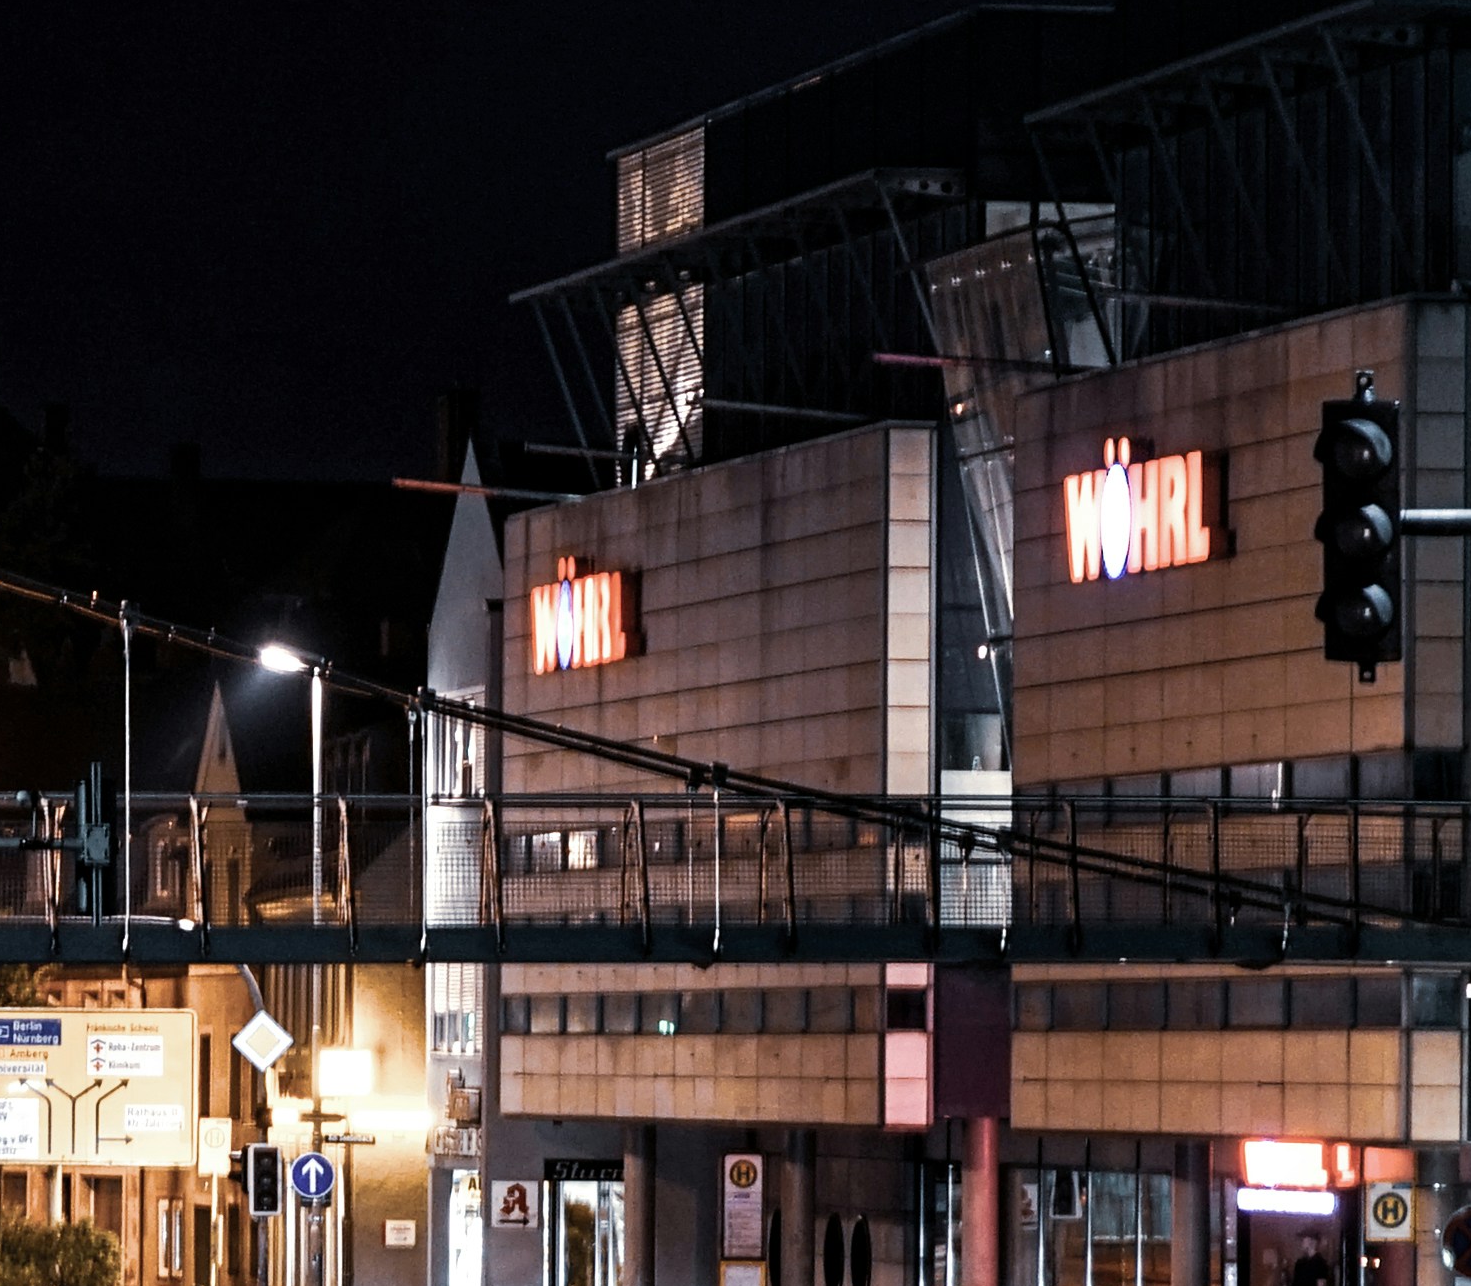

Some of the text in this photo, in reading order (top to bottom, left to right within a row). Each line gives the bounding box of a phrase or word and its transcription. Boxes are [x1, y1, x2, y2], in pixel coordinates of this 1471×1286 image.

[1064, 436, 1210, 583] WÖHRL
[531, 555, 626, 675] WÖHRL
[12, 1020, 42, 1032] Berlin
